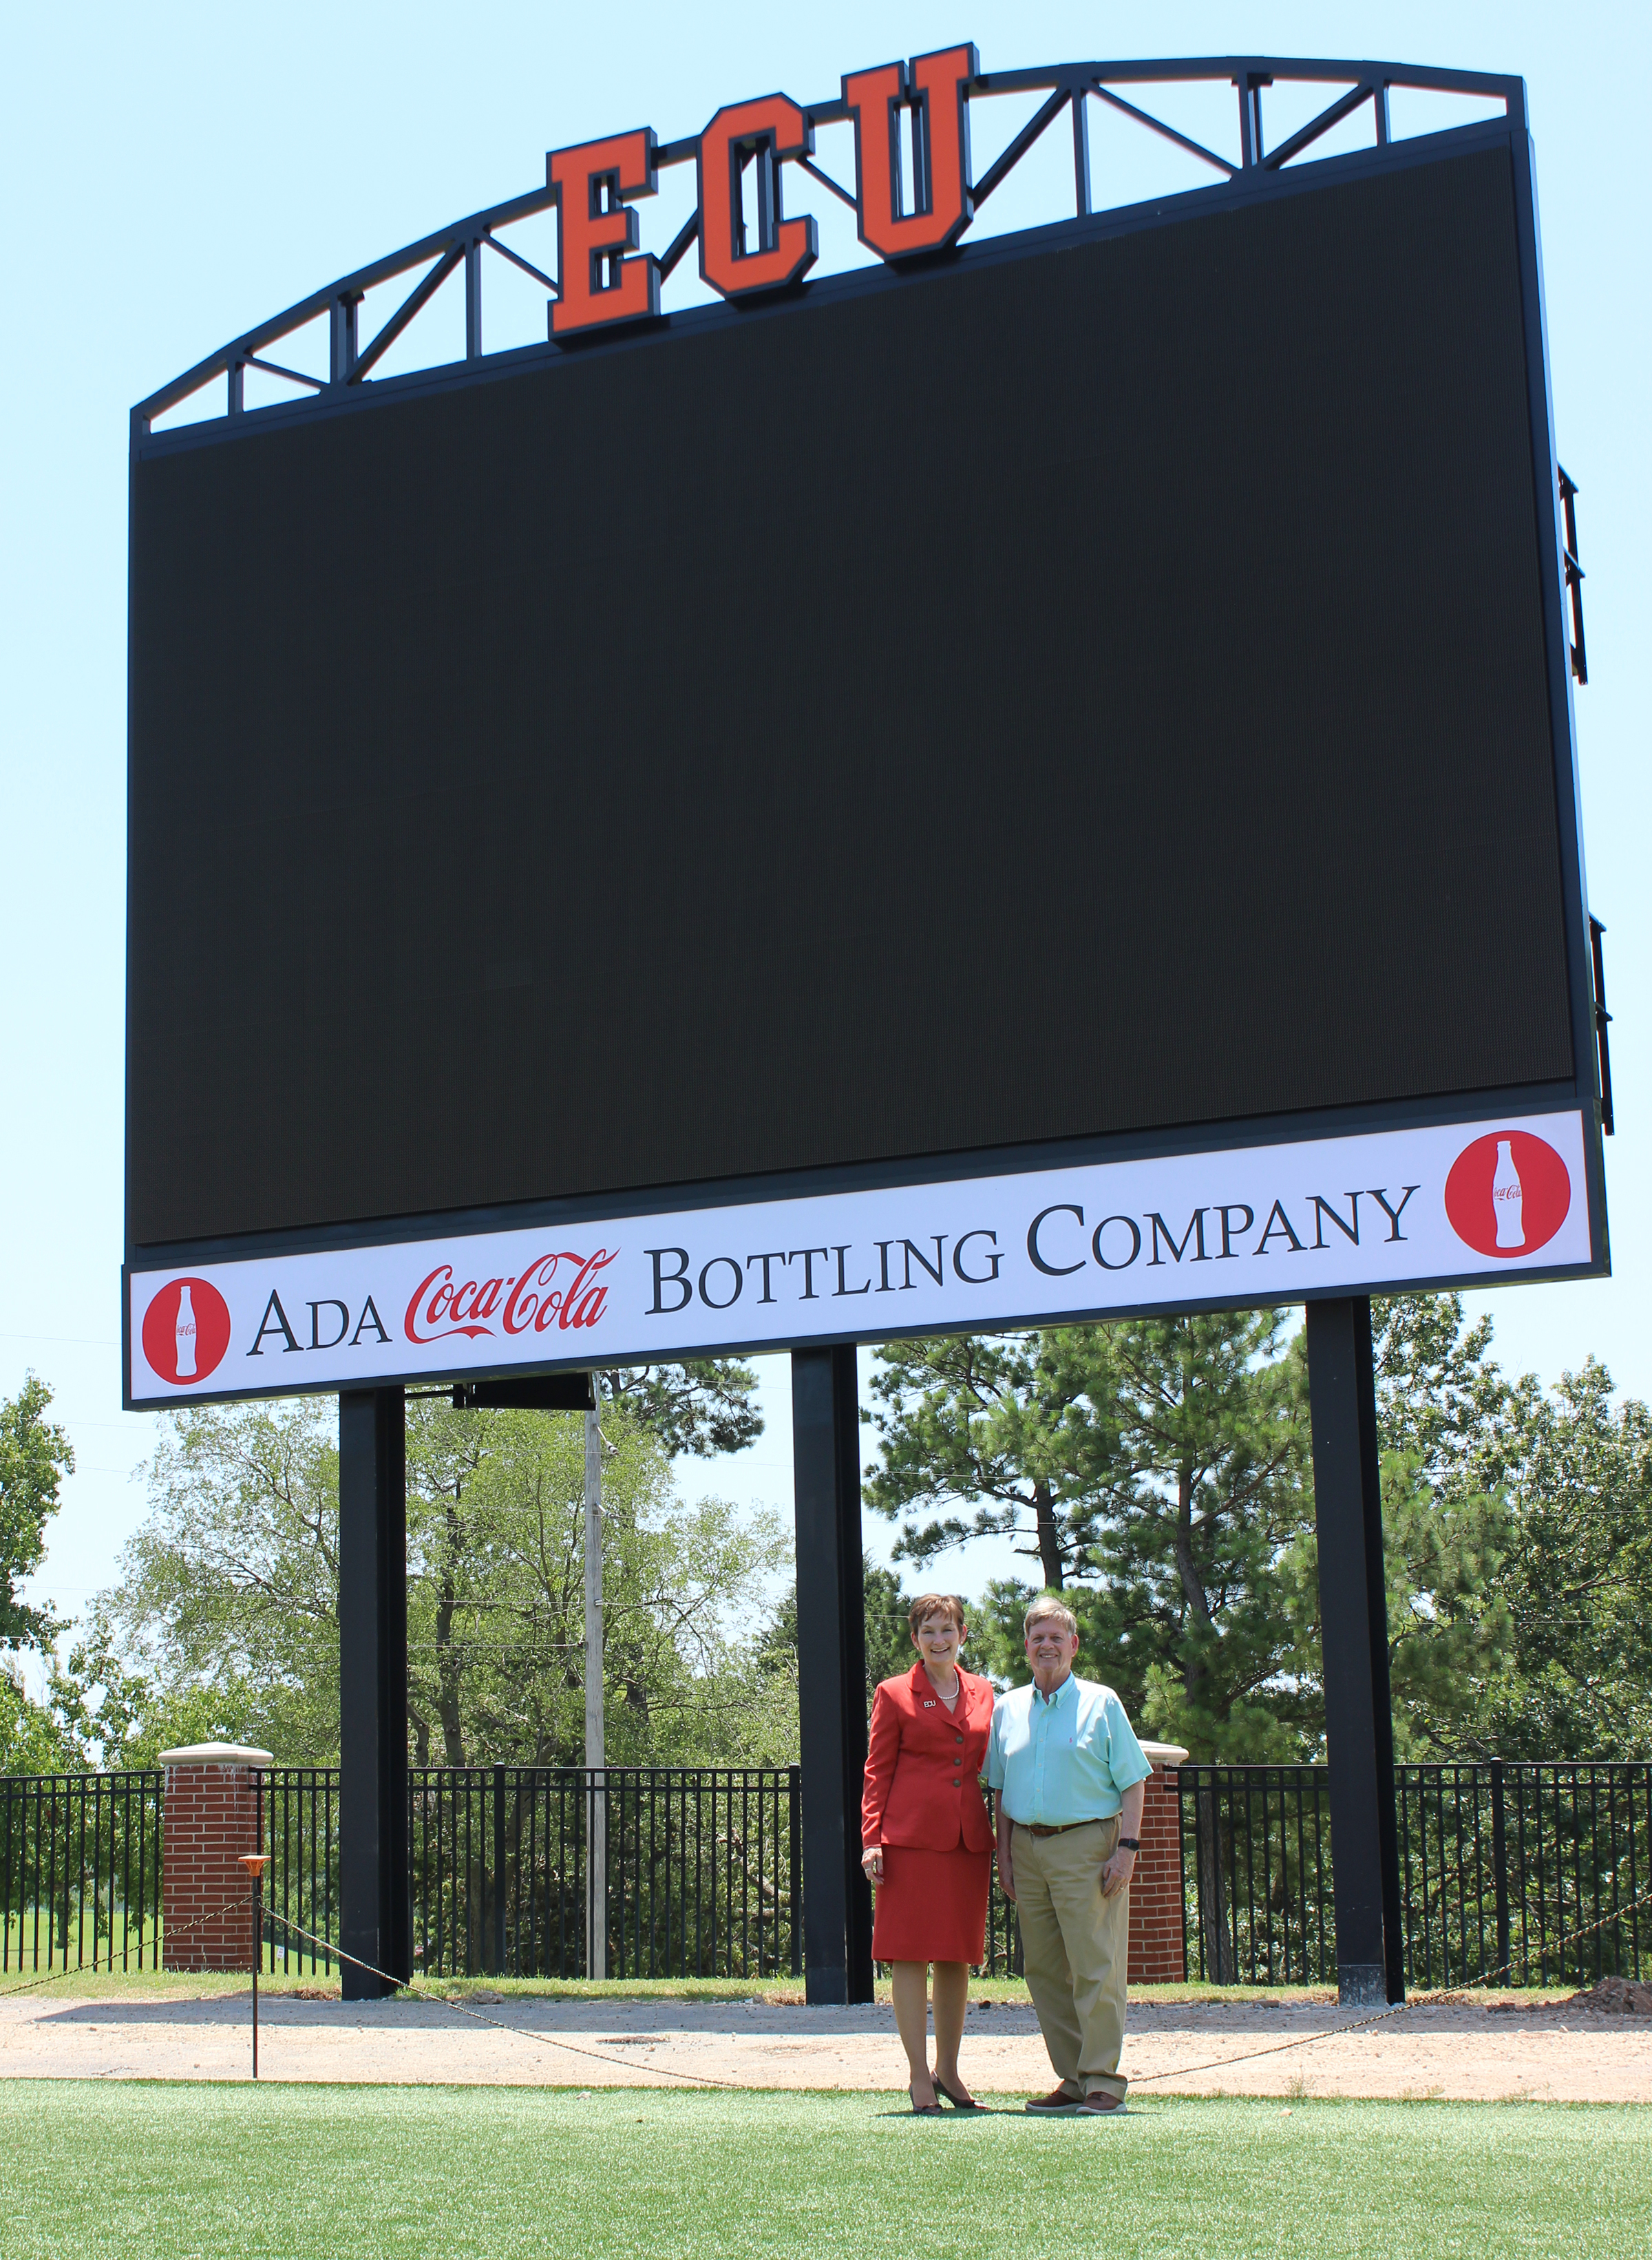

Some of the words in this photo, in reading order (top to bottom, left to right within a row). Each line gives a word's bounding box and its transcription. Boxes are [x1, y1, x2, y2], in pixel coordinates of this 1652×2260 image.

[547, 42, 979, 339] ECU
[246, 1289, 393, 1356] ADA
[404, 1247, 622, 1344] Coca-Cola
[643, 1229, 1006, 1316] BOTTLING
[1026, 1185, 1421, 1277] COMPANY
[923, 1700, 936, 1708] ECU
